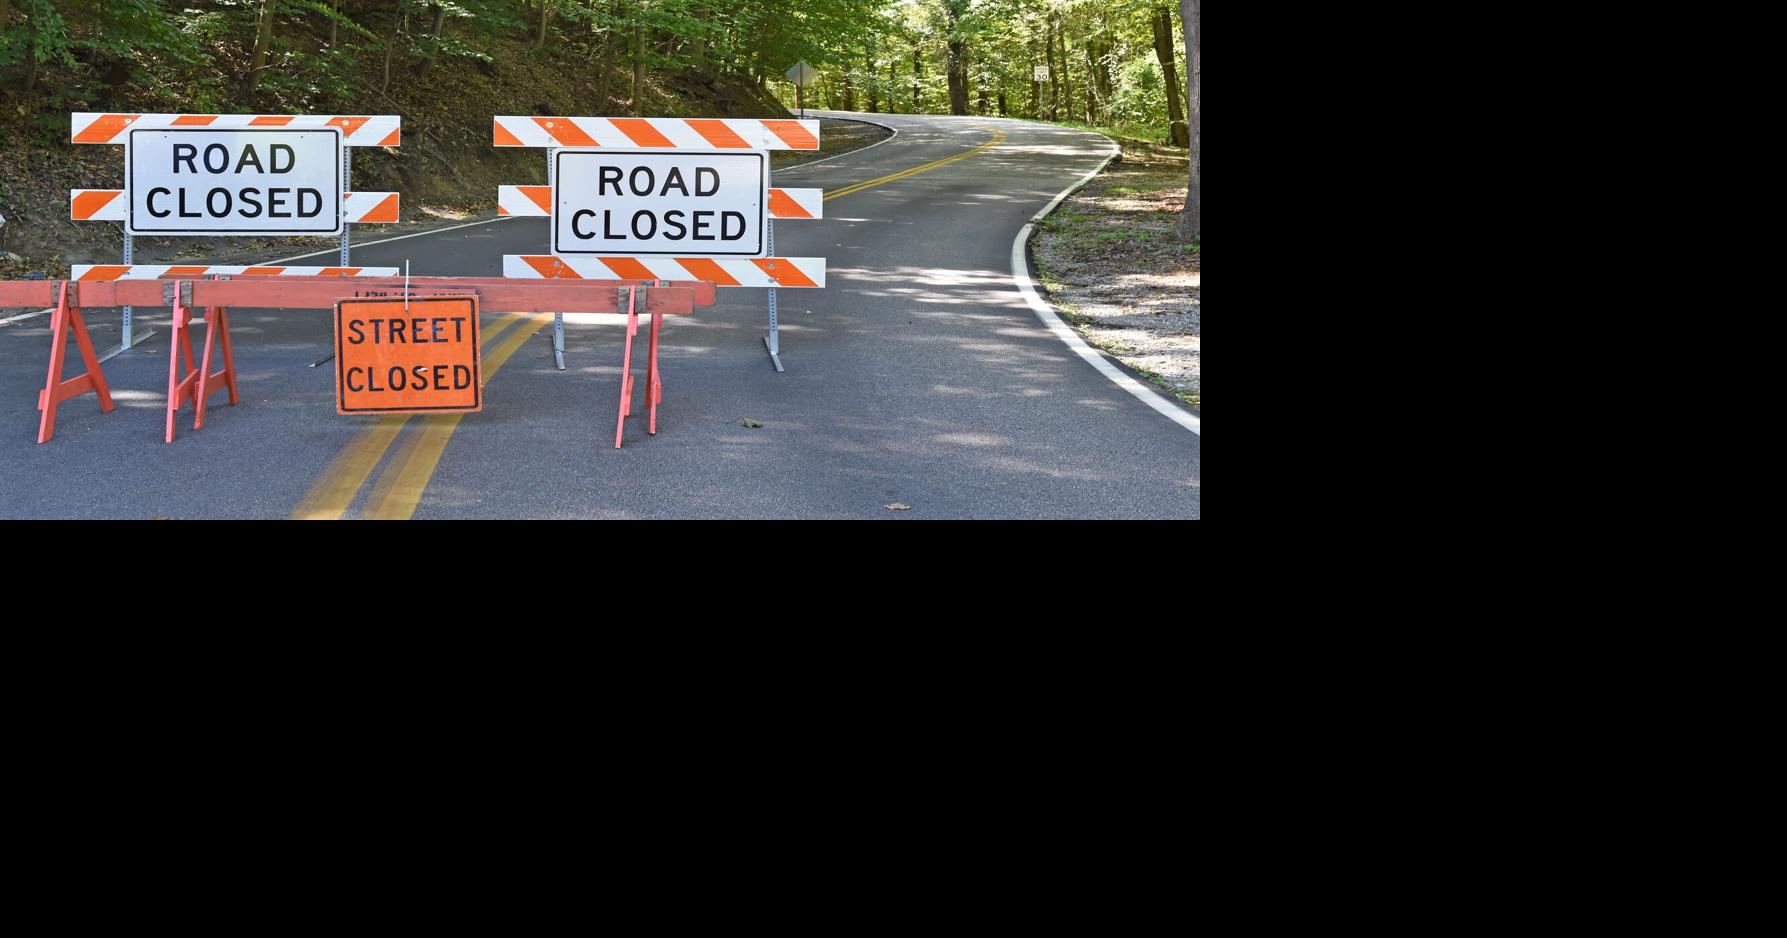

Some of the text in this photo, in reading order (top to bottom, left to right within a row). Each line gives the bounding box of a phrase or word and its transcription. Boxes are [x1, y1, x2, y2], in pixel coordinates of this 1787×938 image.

[173, 144, 296, 174] ROAD
[599, 166, 720, 197] ROAD
[147, 187, 323, 219] CLOSED
[572, 210, 747, 241] CLOSED
[348, 317, 466, 344] STREET
[346, 364, 471, 392] CLOSED
